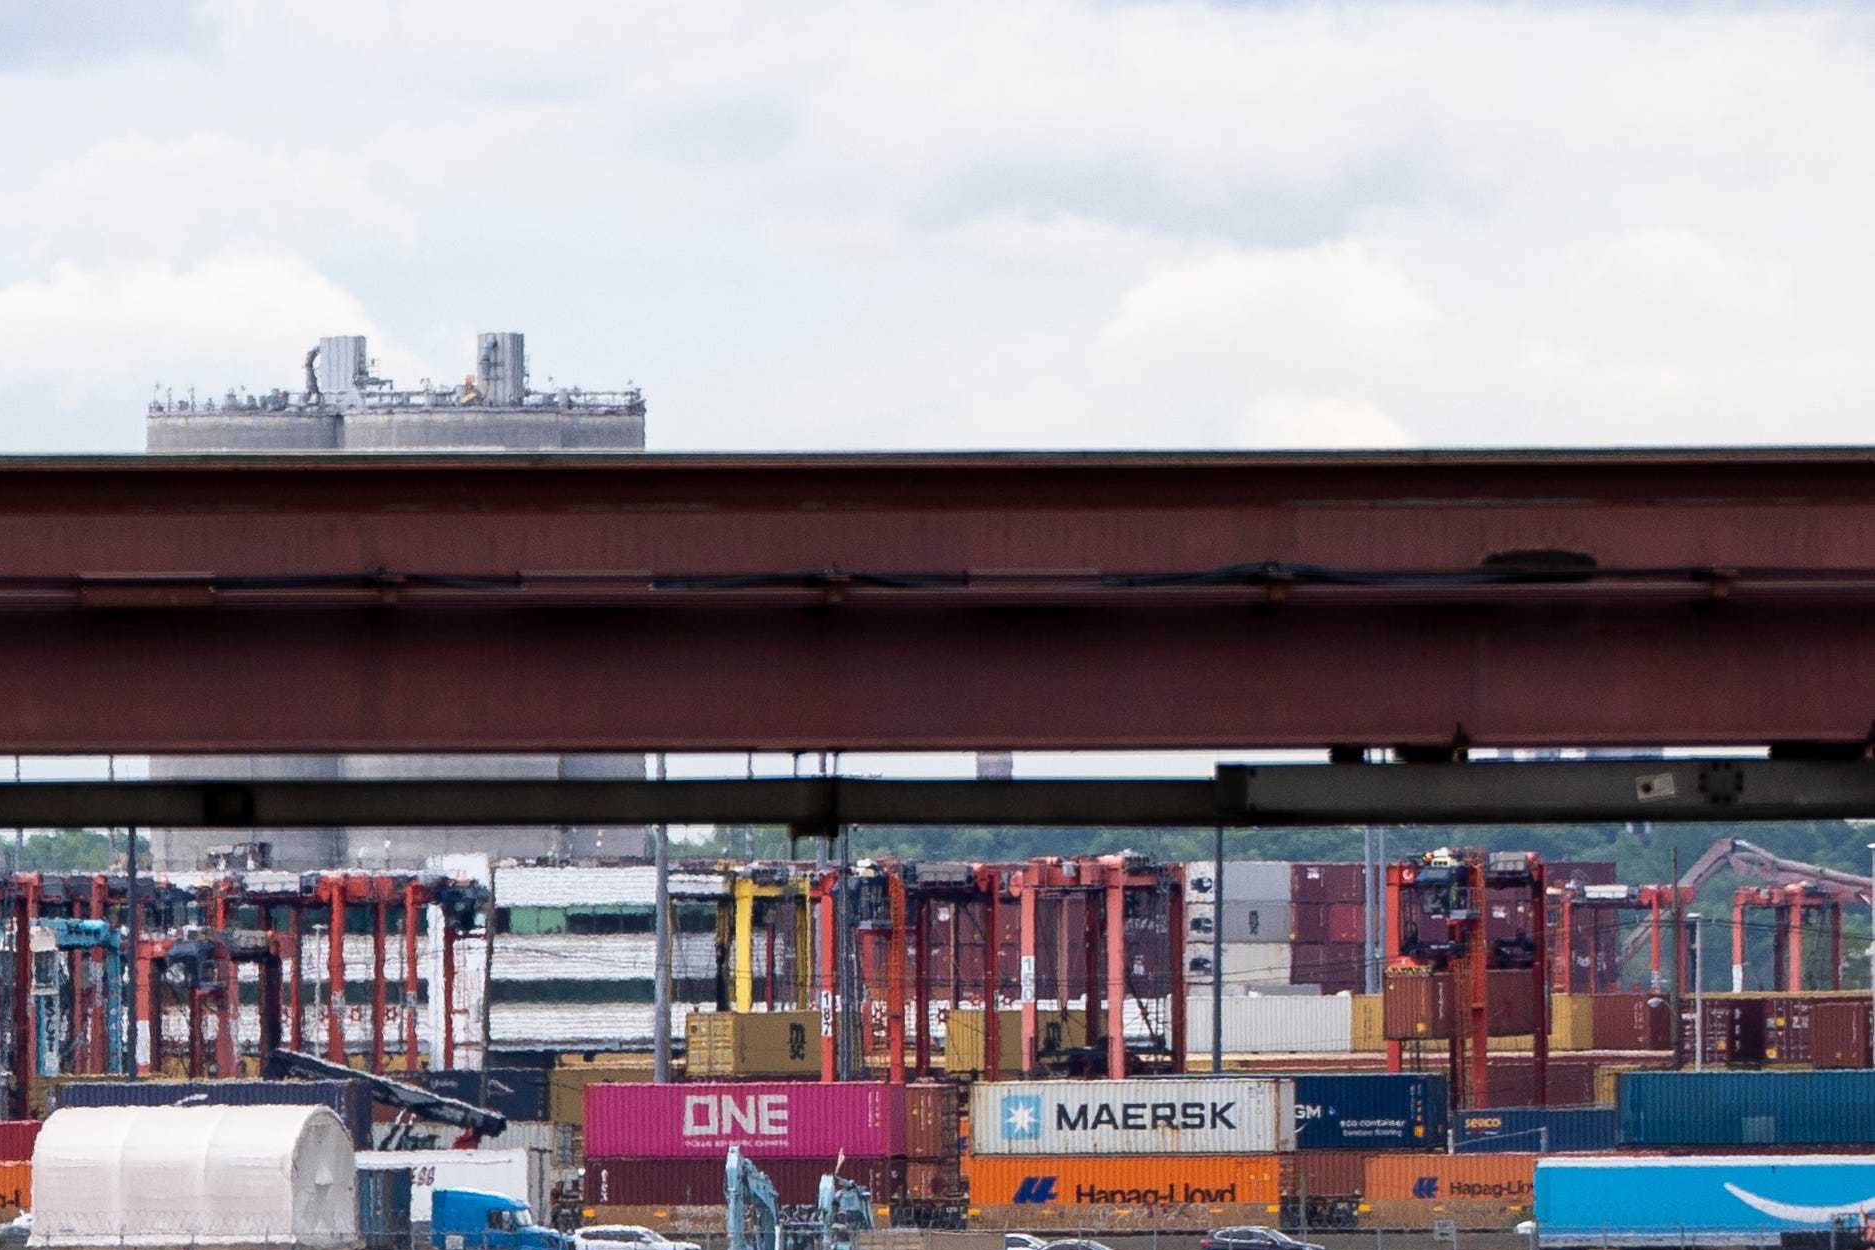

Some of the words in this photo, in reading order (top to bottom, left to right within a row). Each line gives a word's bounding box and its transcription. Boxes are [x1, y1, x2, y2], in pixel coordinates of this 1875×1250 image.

[683, 1094, 789, 1136] ONE
[1056, 1101, 1237, 1131] MAERSK
[1293, 1104, 1321, 1119] GM
[1465, 1117, 1502, 1129] seaco
[1450, 1180, 1533, 1197] Hapag-Llo
